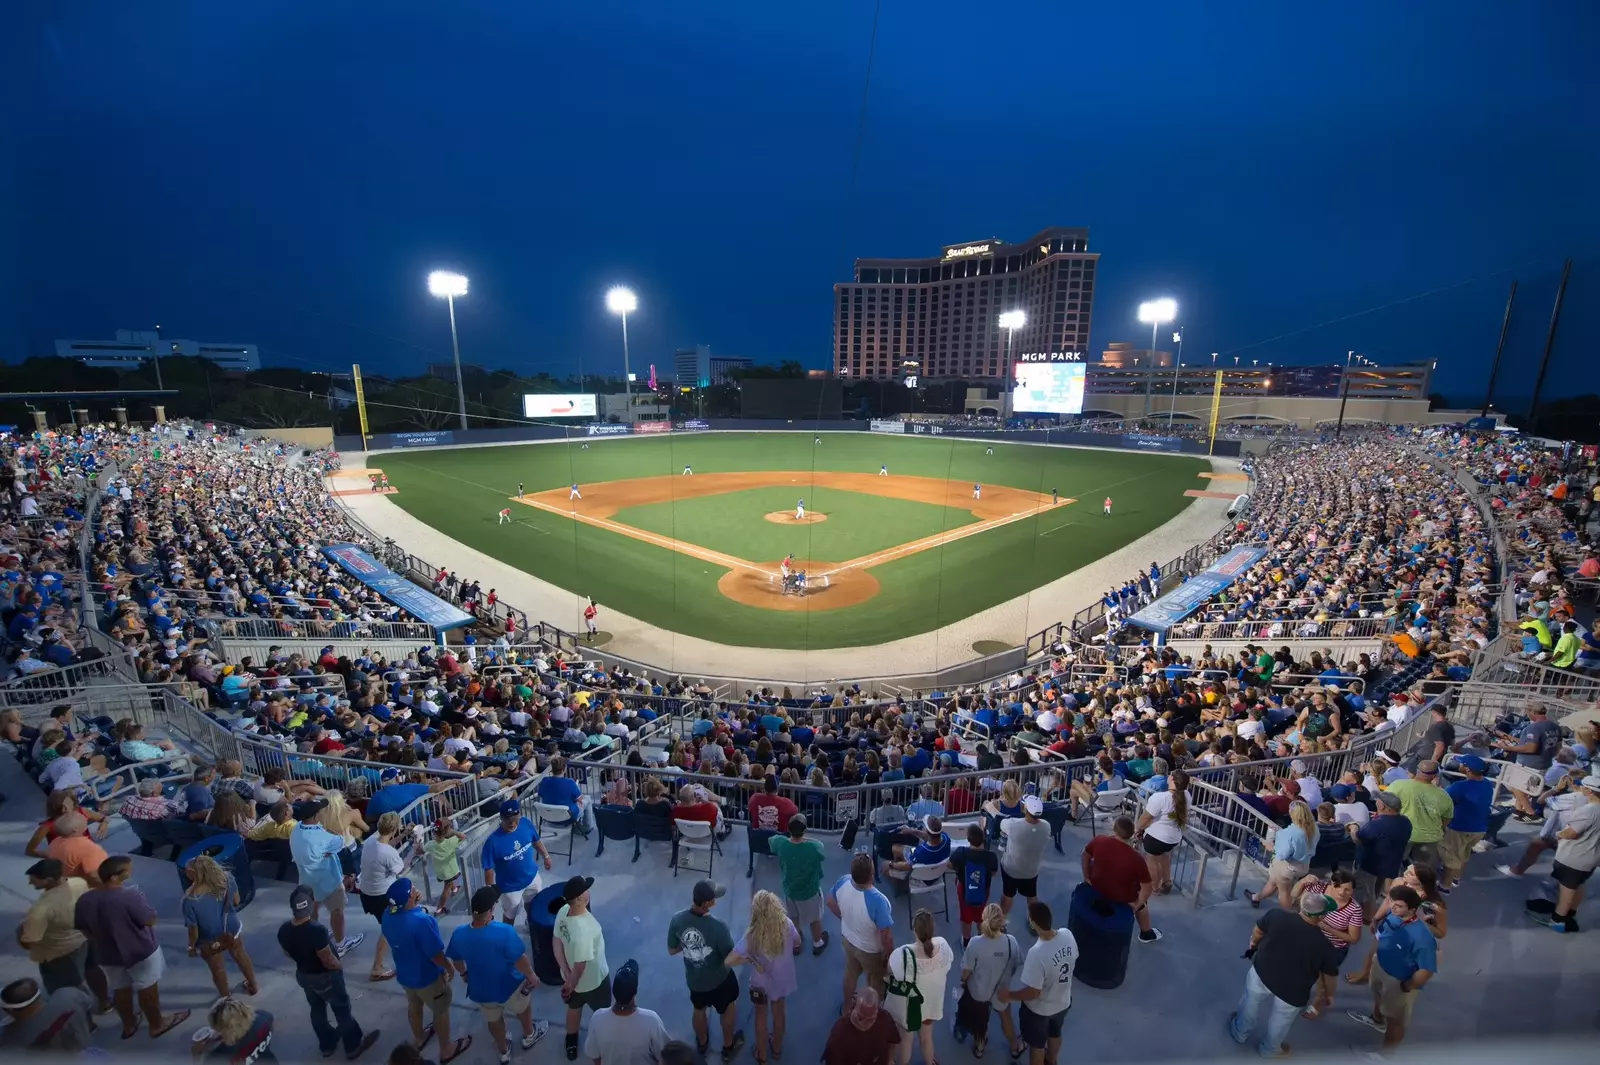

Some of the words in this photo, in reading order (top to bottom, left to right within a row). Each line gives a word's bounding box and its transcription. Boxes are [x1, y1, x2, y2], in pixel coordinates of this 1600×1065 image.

[1022, 353, 1046, 361] MGM
[1051, 352, 1081, 360] PARK
[1051, 946, 1072, 967] JETER
[1058, 962, 1070, 983] 2
